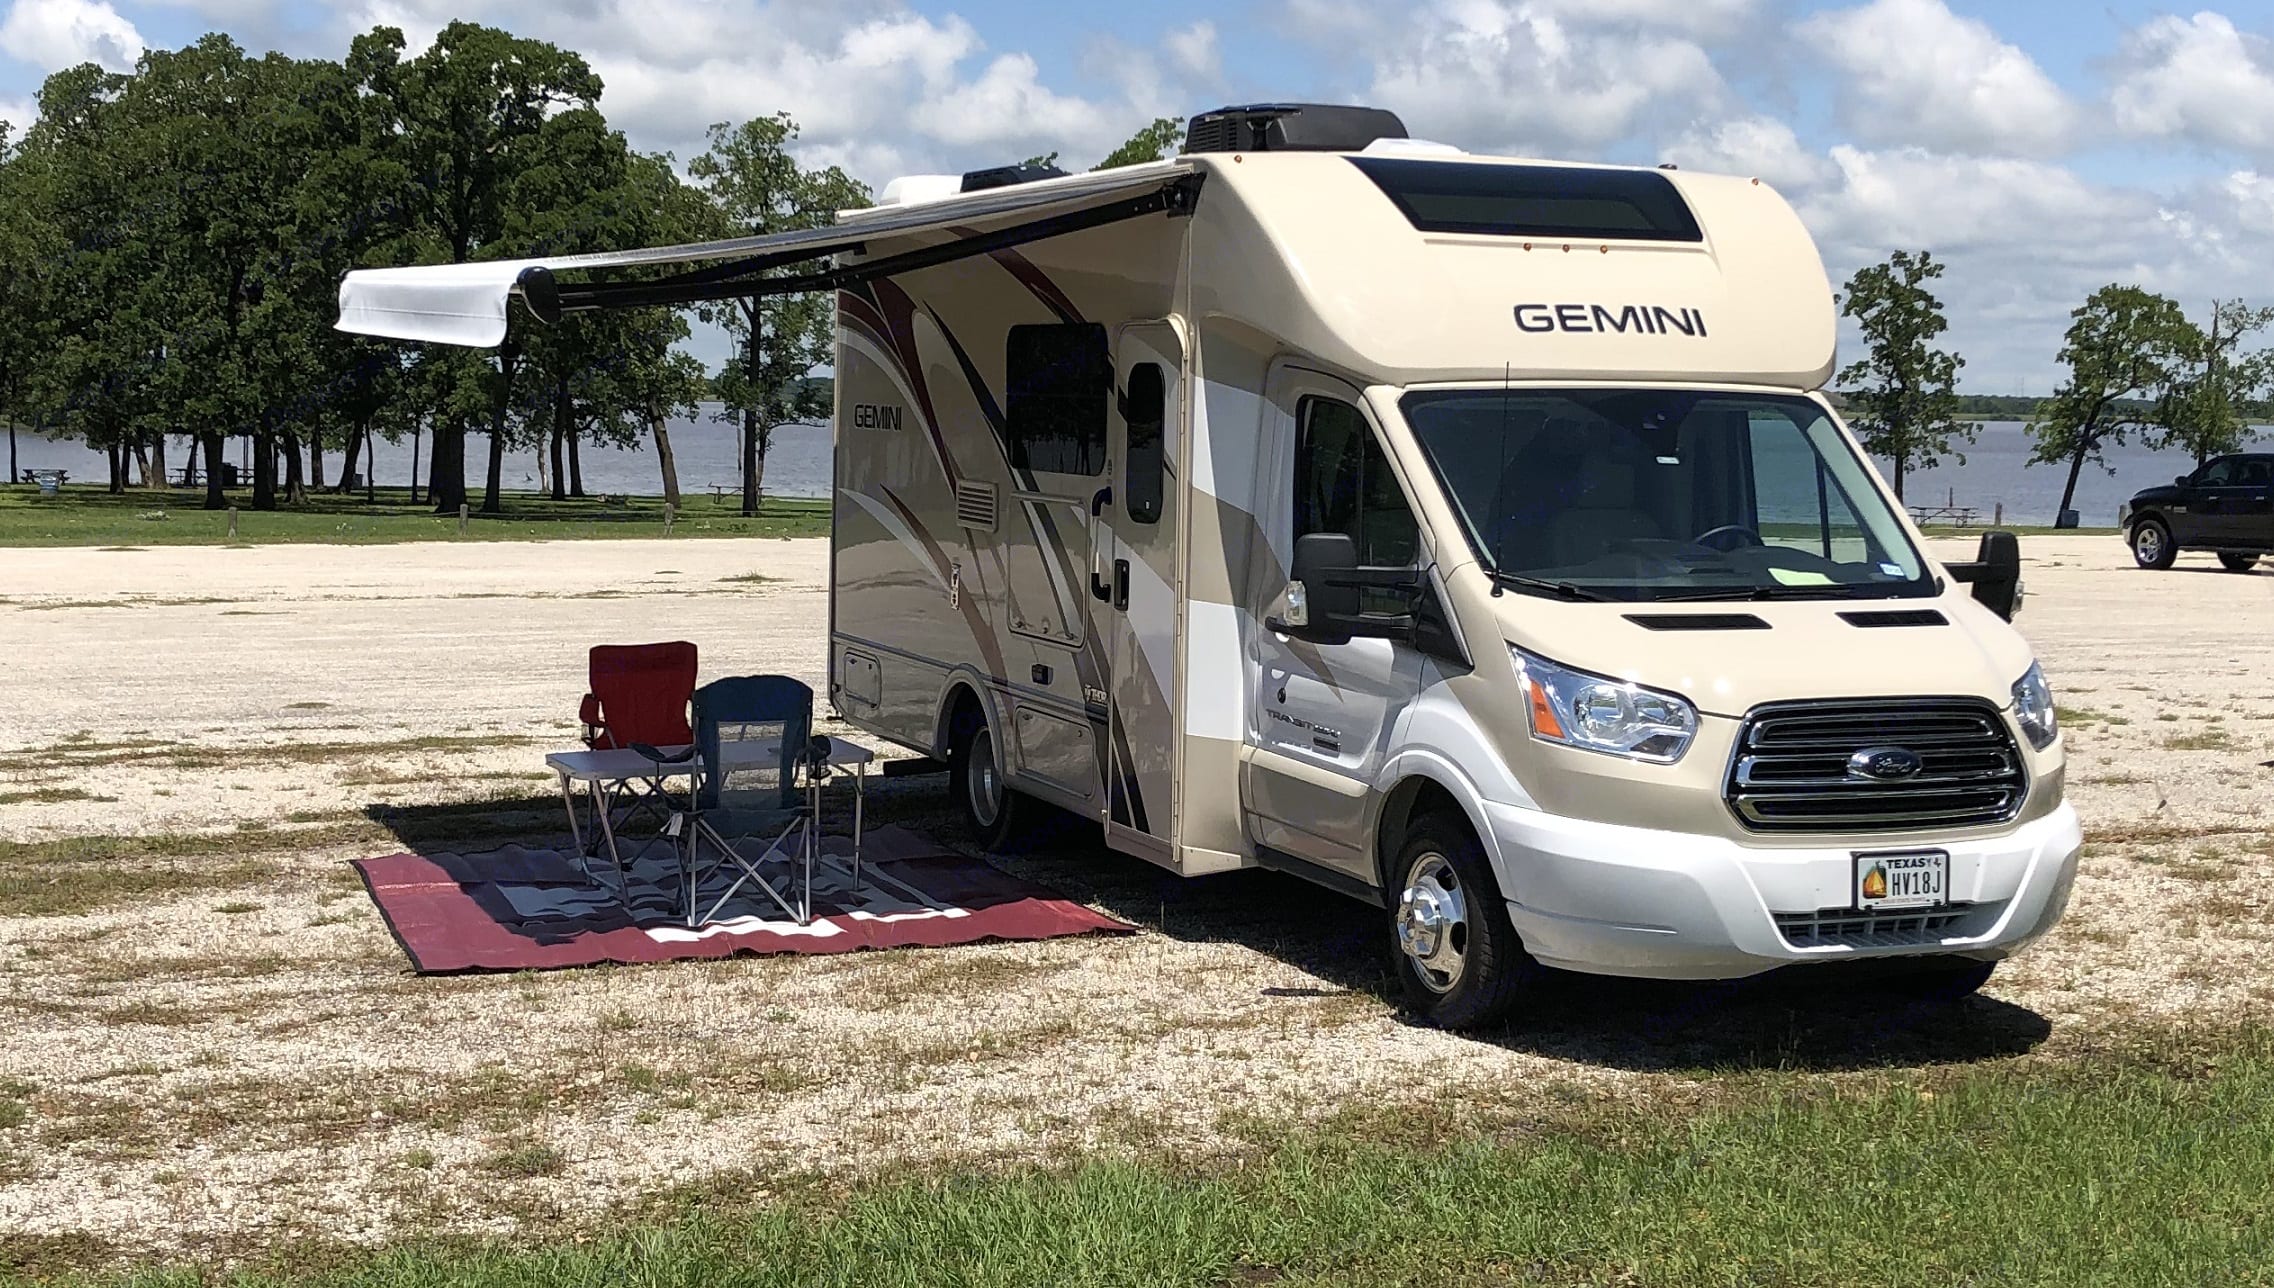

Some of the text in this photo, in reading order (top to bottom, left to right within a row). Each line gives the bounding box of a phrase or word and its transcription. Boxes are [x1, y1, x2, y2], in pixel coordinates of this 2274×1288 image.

[1513, 304, 1708, 338] GEMINI
[854, 404, 902, 431] GEMINI
[1266, 709, 1312, 730] TRANSIT
[1875, 757, 1913, 775] Ford
[1886, 857, 1926, 869] TEXAS
[1892, 870, 1941, 896] HV18J
